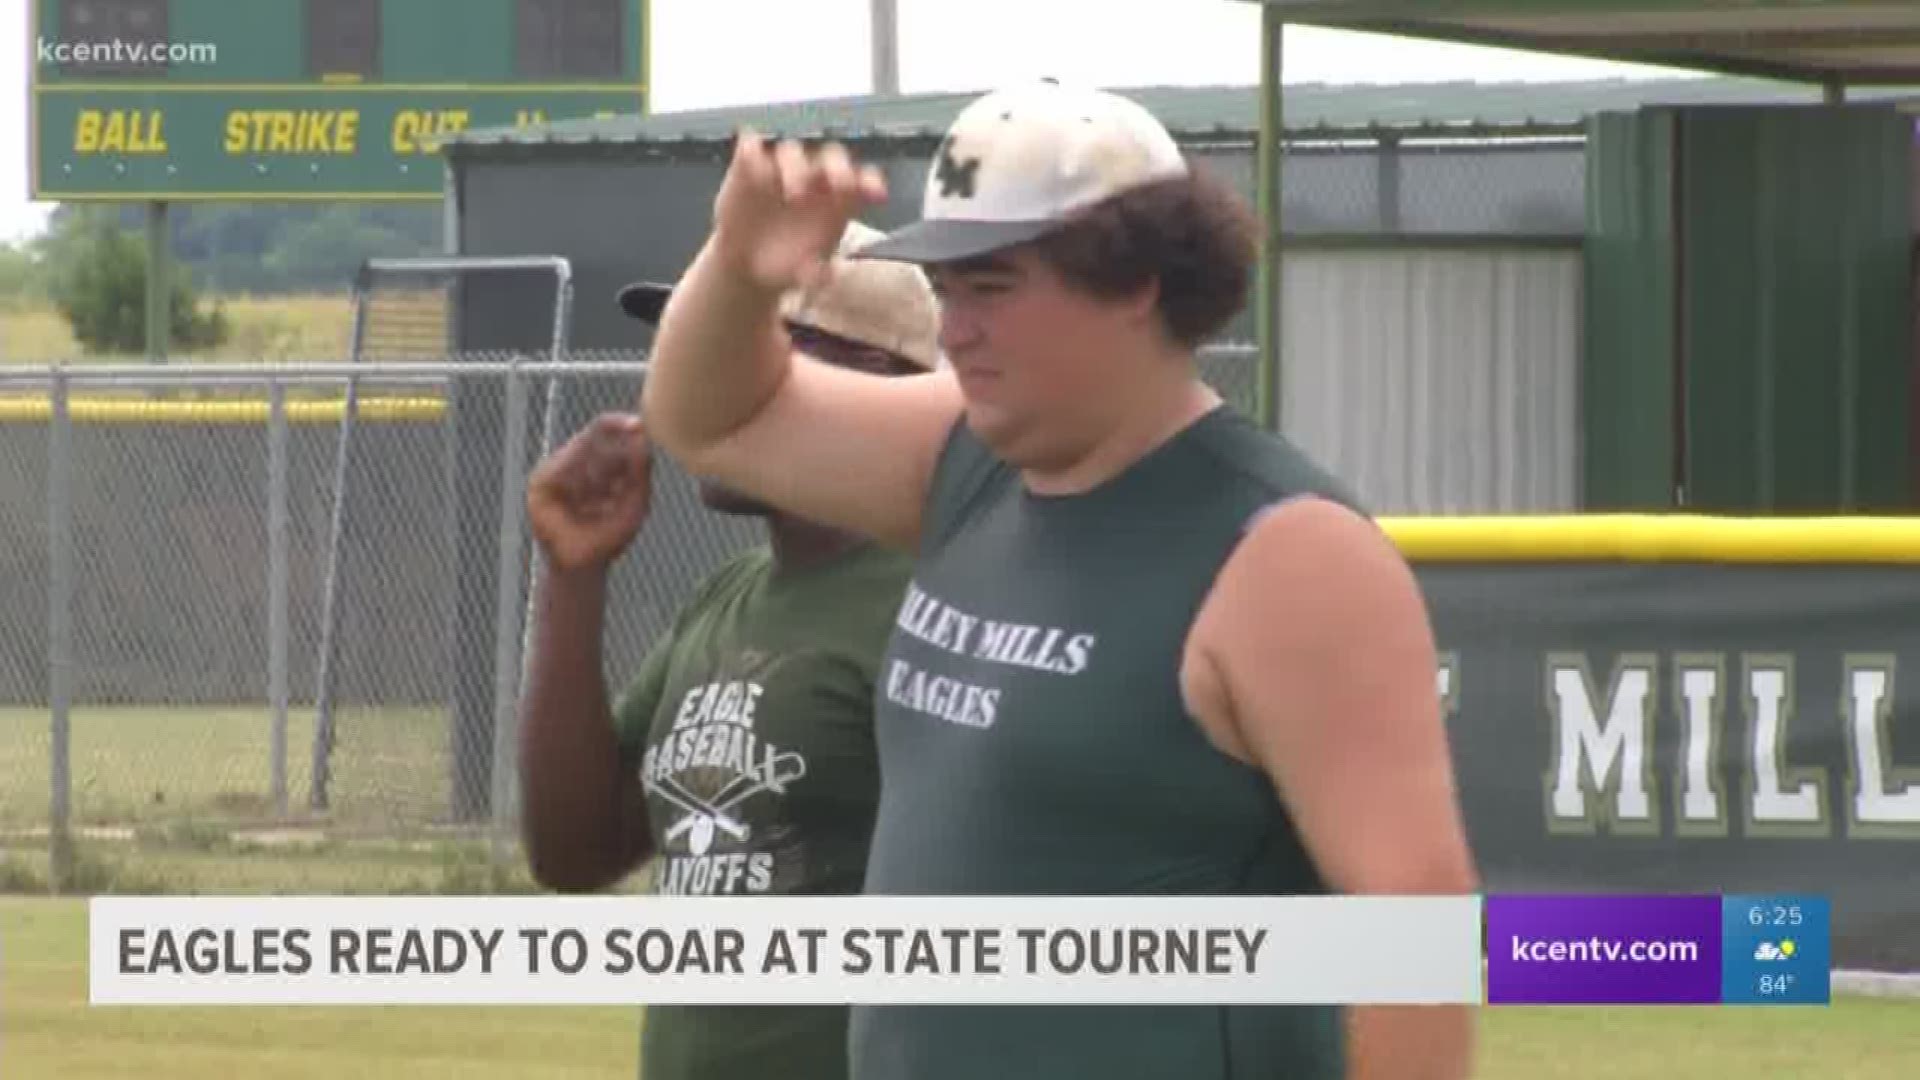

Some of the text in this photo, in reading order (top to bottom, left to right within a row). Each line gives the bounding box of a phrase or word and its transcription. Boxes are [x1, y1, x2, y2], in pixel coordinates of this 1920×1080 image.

[75, 109, 168, 154] BALL
[224, 109, 359, 154] STRIKE
[897, 580, 1095, 676] LLEY MILLS
[673, 682, 764, 729] EAGLE
[887, 659, 1001, 729] EAGLES
